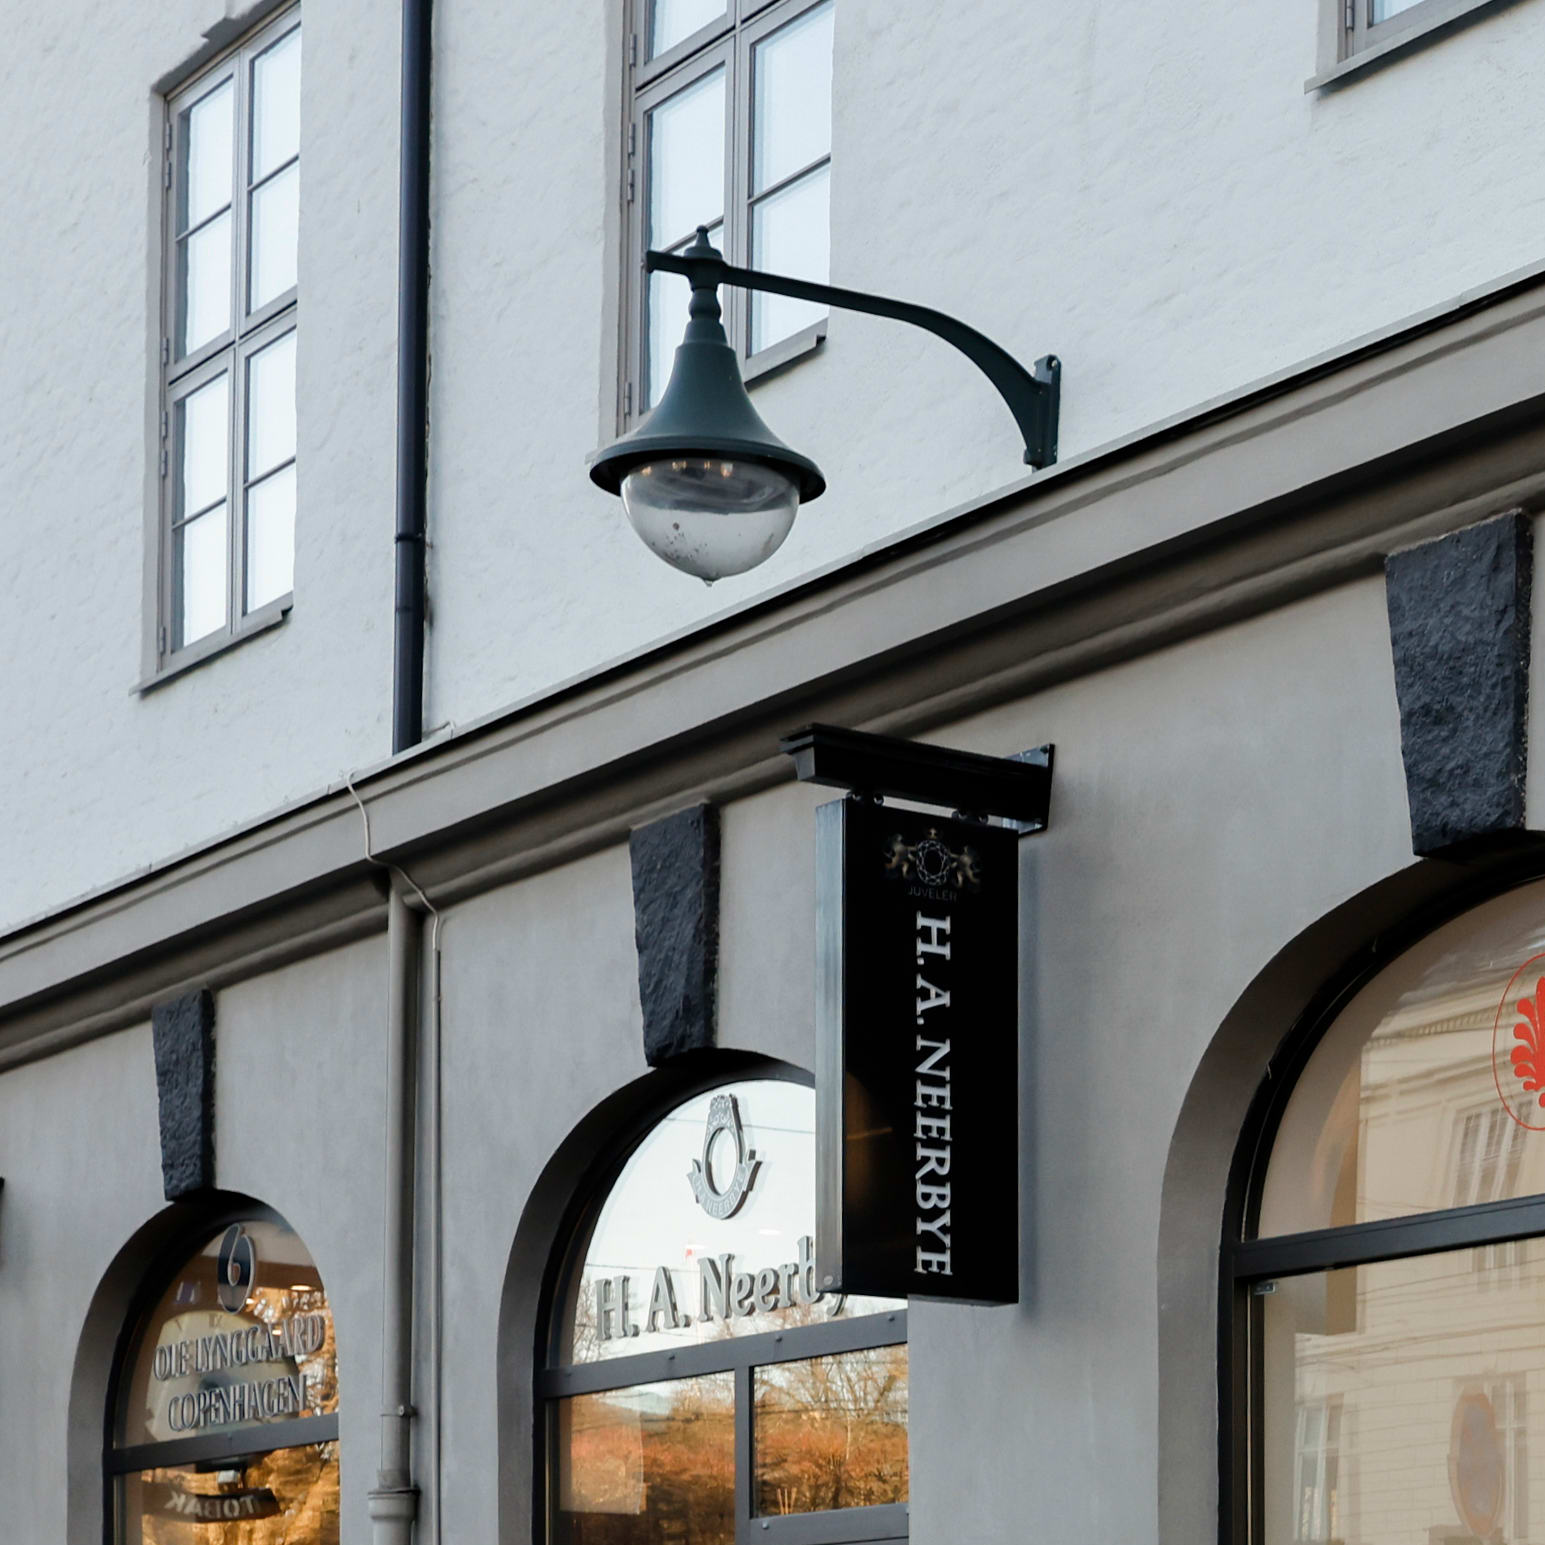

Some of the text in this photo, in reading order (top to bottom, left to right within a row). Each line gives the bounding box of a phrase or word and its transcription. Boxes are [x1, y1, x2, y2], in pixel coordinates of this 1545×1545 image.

[914, 1035, 953, 1275] NEERBYE
[698, 1235, 848, 1322] Neerb
[154, 1315, 325, 1381] OLE LYNGGAARD
[168, 1374, 308, 1432] COPENHAGEN
